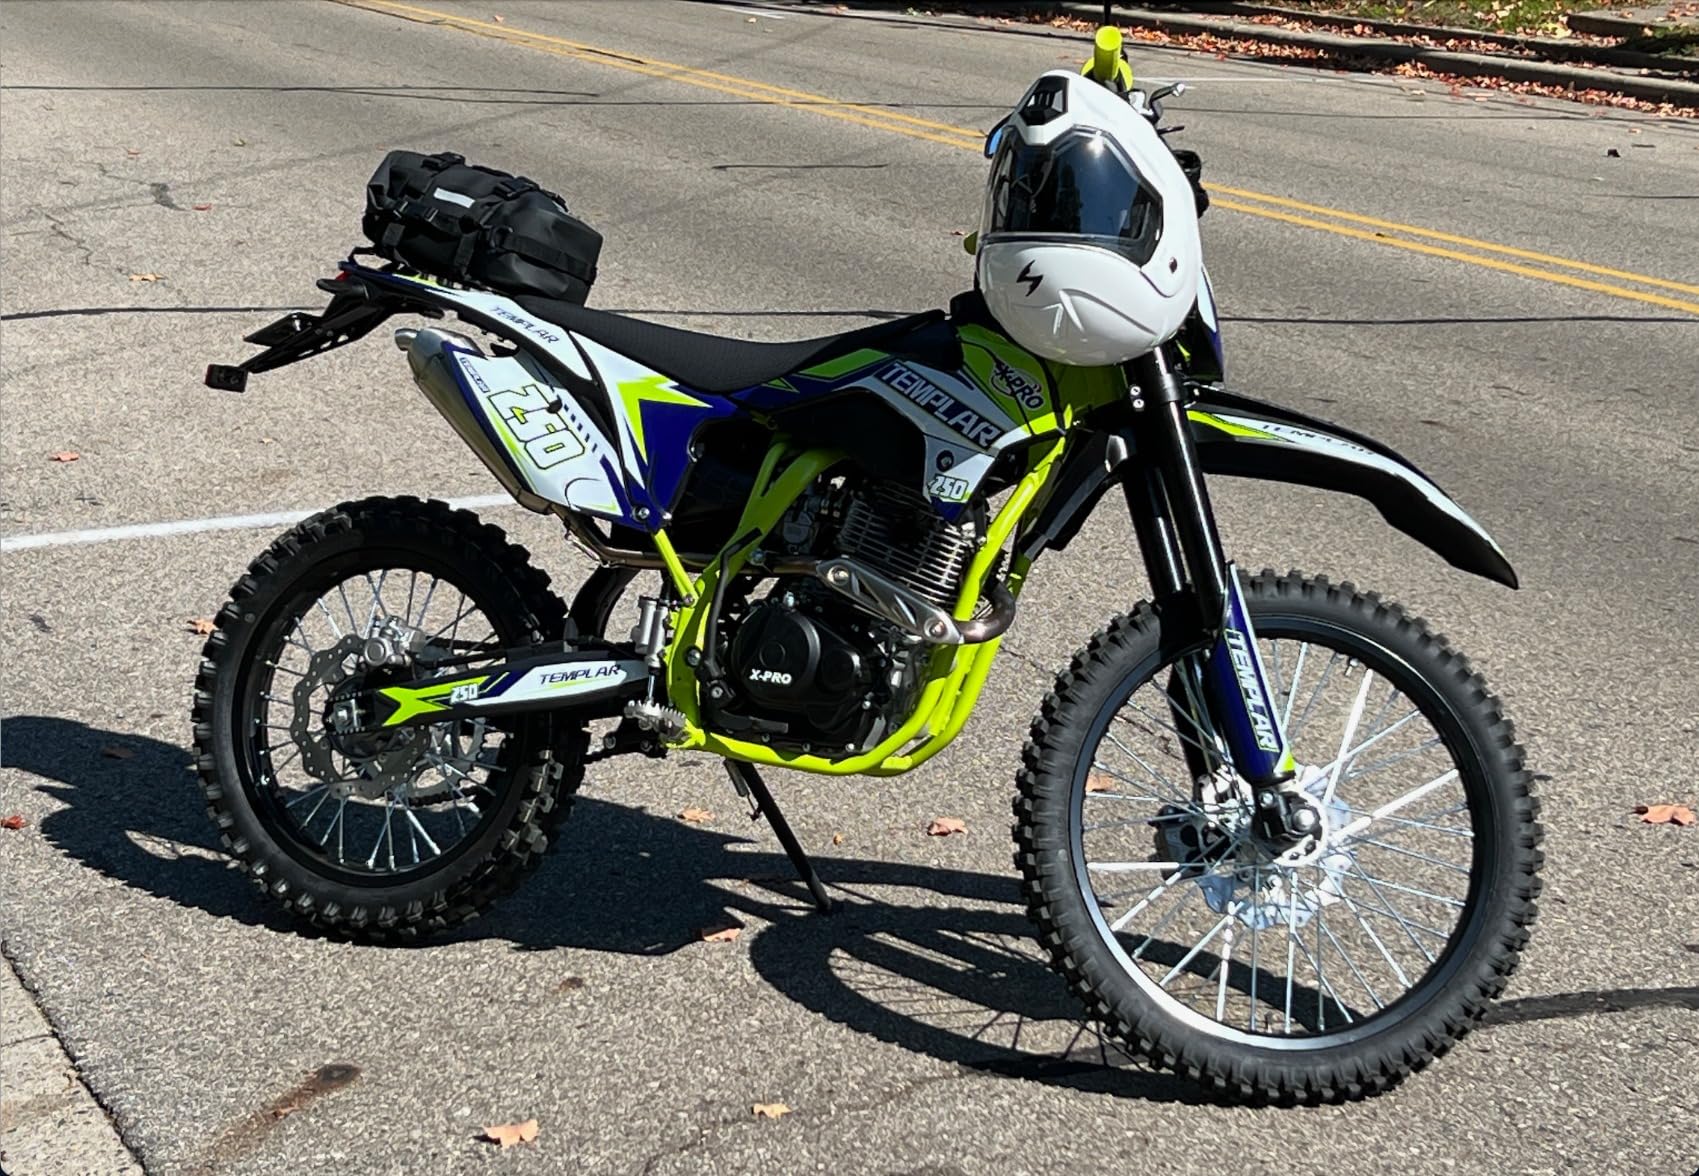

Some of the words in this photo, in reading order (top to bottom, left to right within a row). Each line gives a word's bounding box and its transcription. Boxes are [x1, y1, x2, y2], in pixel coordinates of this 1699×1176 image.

[881, 361, 1001, 448] TEMPLAR
[487, 383, 585, 470] 250
[929, 474, 968, 501] 250
[540, 664, 620, 685] TEMPLAR
[749, 668, 792, 685] X-PRO
[450, 683, 479, 703] 250
[1225, 628, 1280, 752] TEMPLAR
